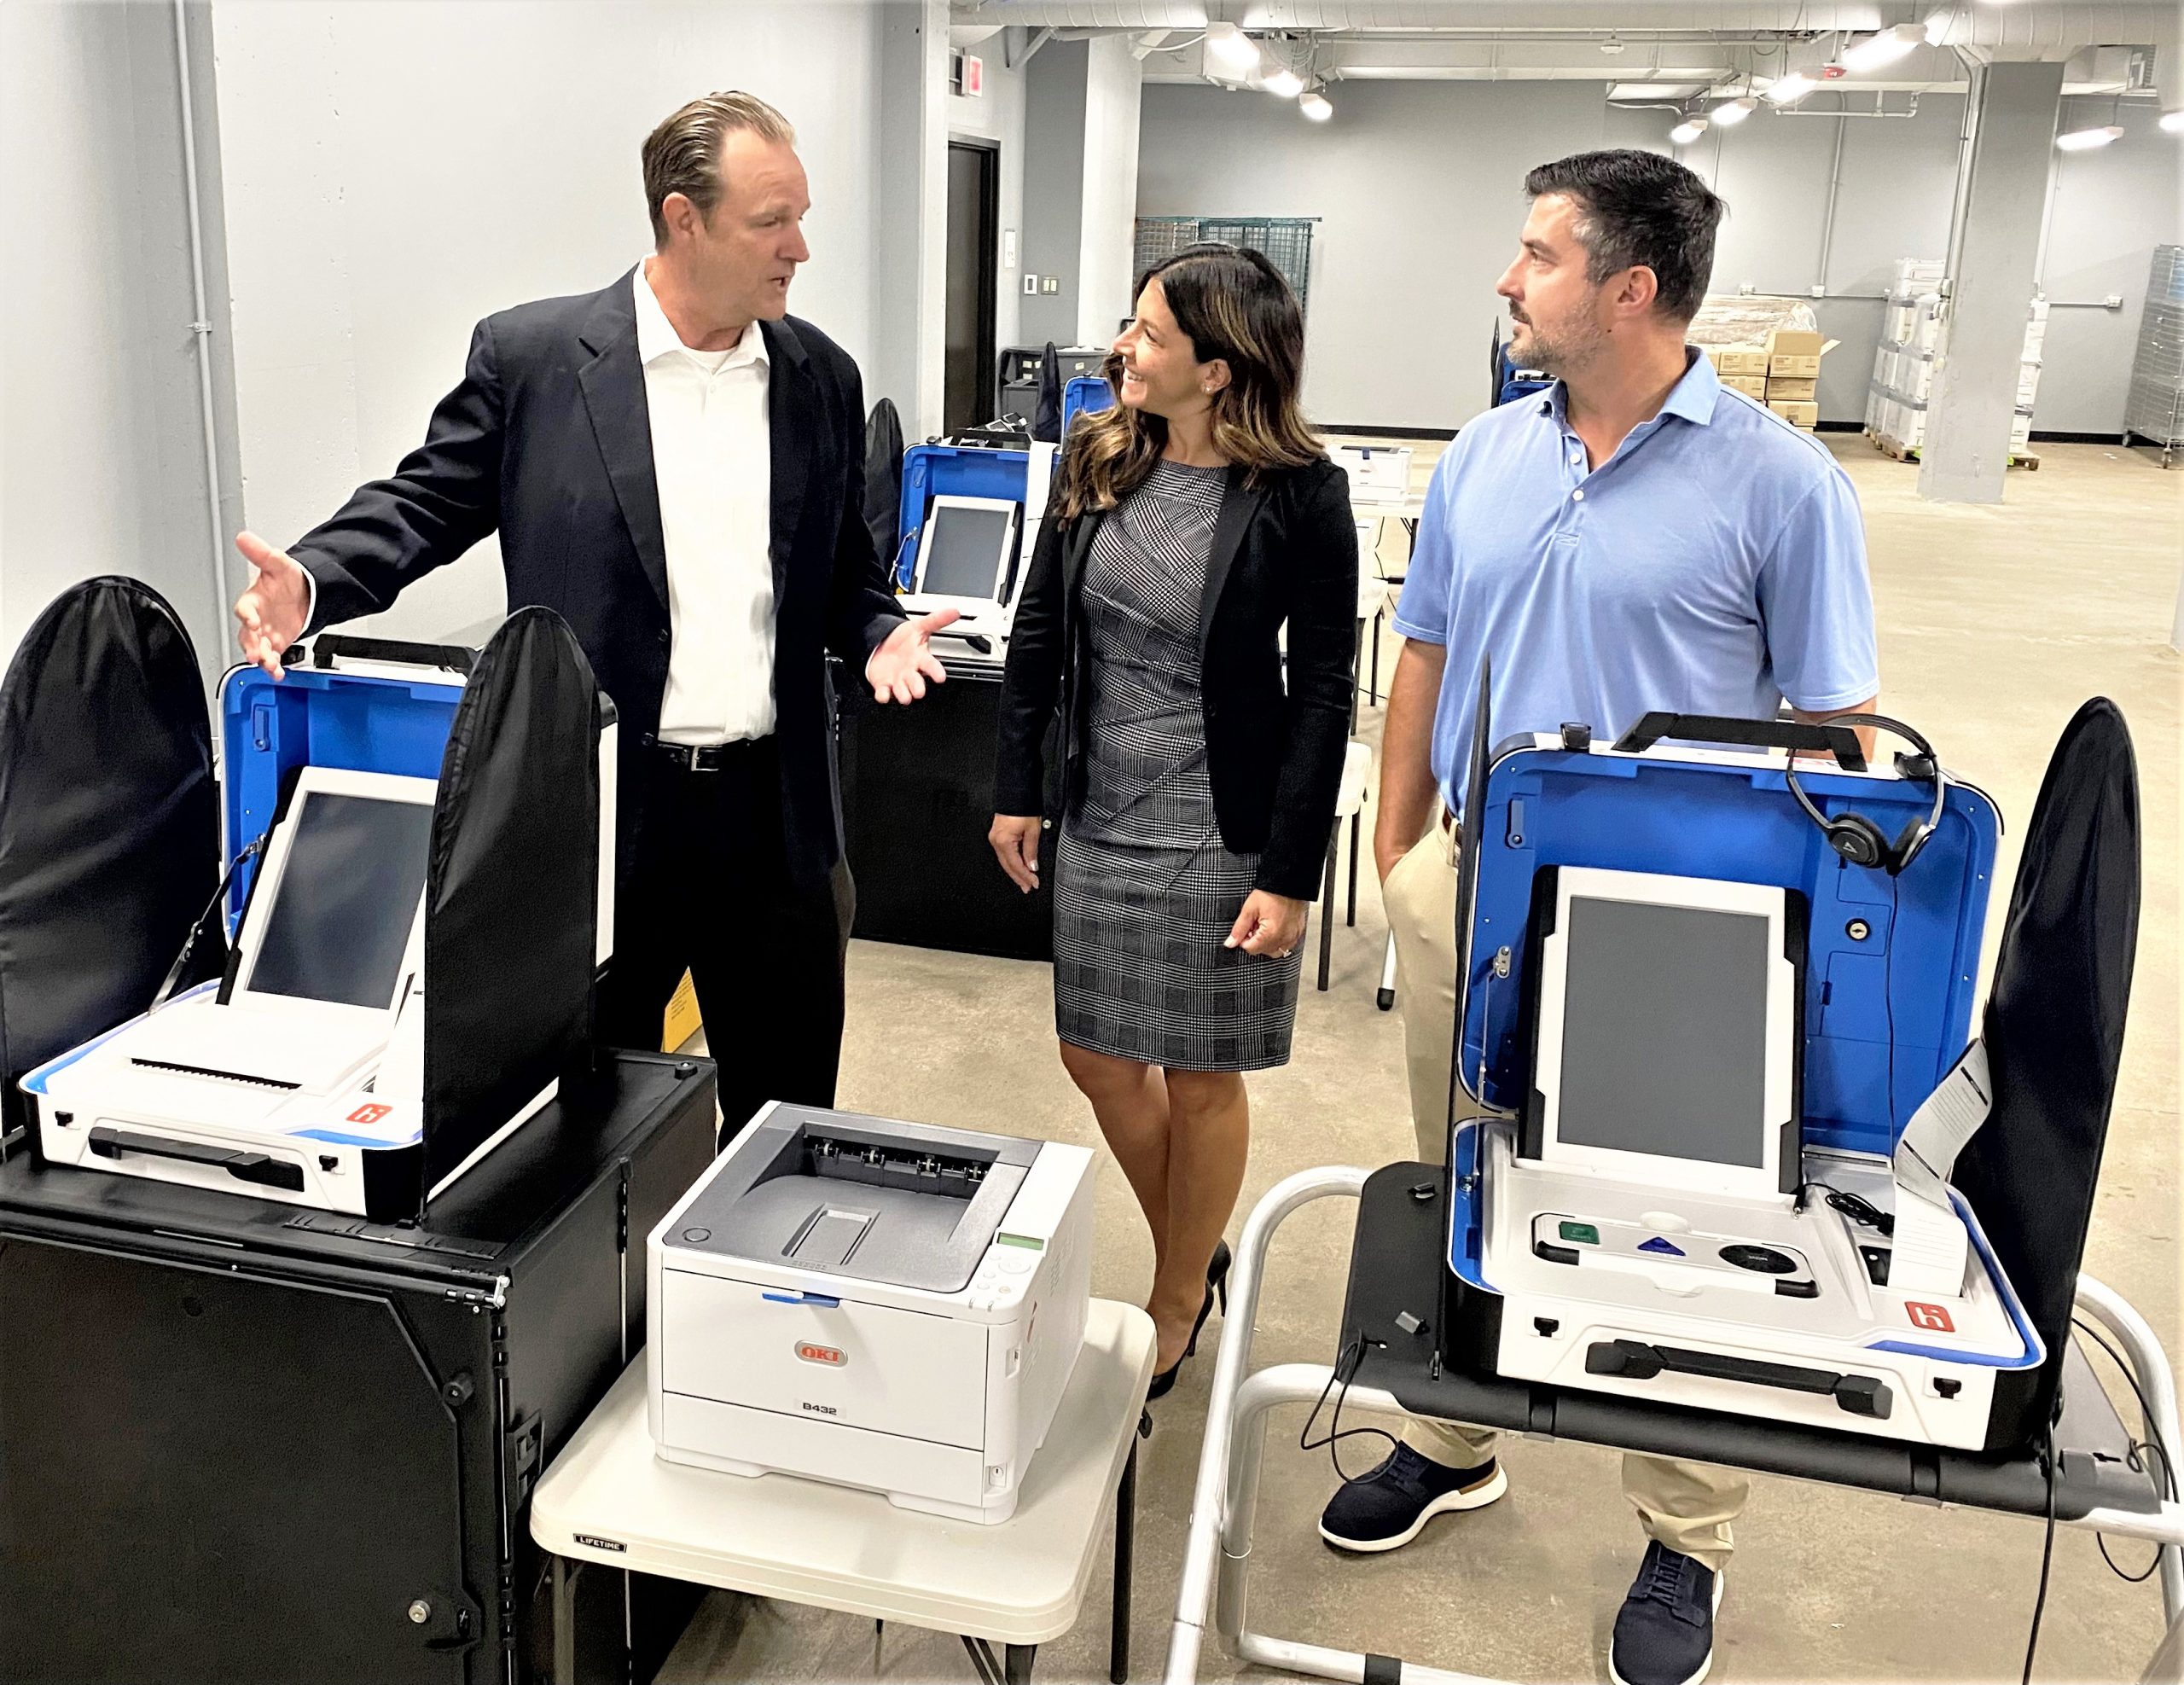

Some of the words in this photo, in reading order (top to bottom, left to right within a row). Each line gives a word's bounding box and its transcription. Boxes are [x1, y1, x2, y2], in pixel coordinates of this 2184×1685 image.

[801, 1346, 839, 1363] OKI
[803, 1402, 837, 1415] B432
[580, 1536, 620, 1550] LIFETIME
